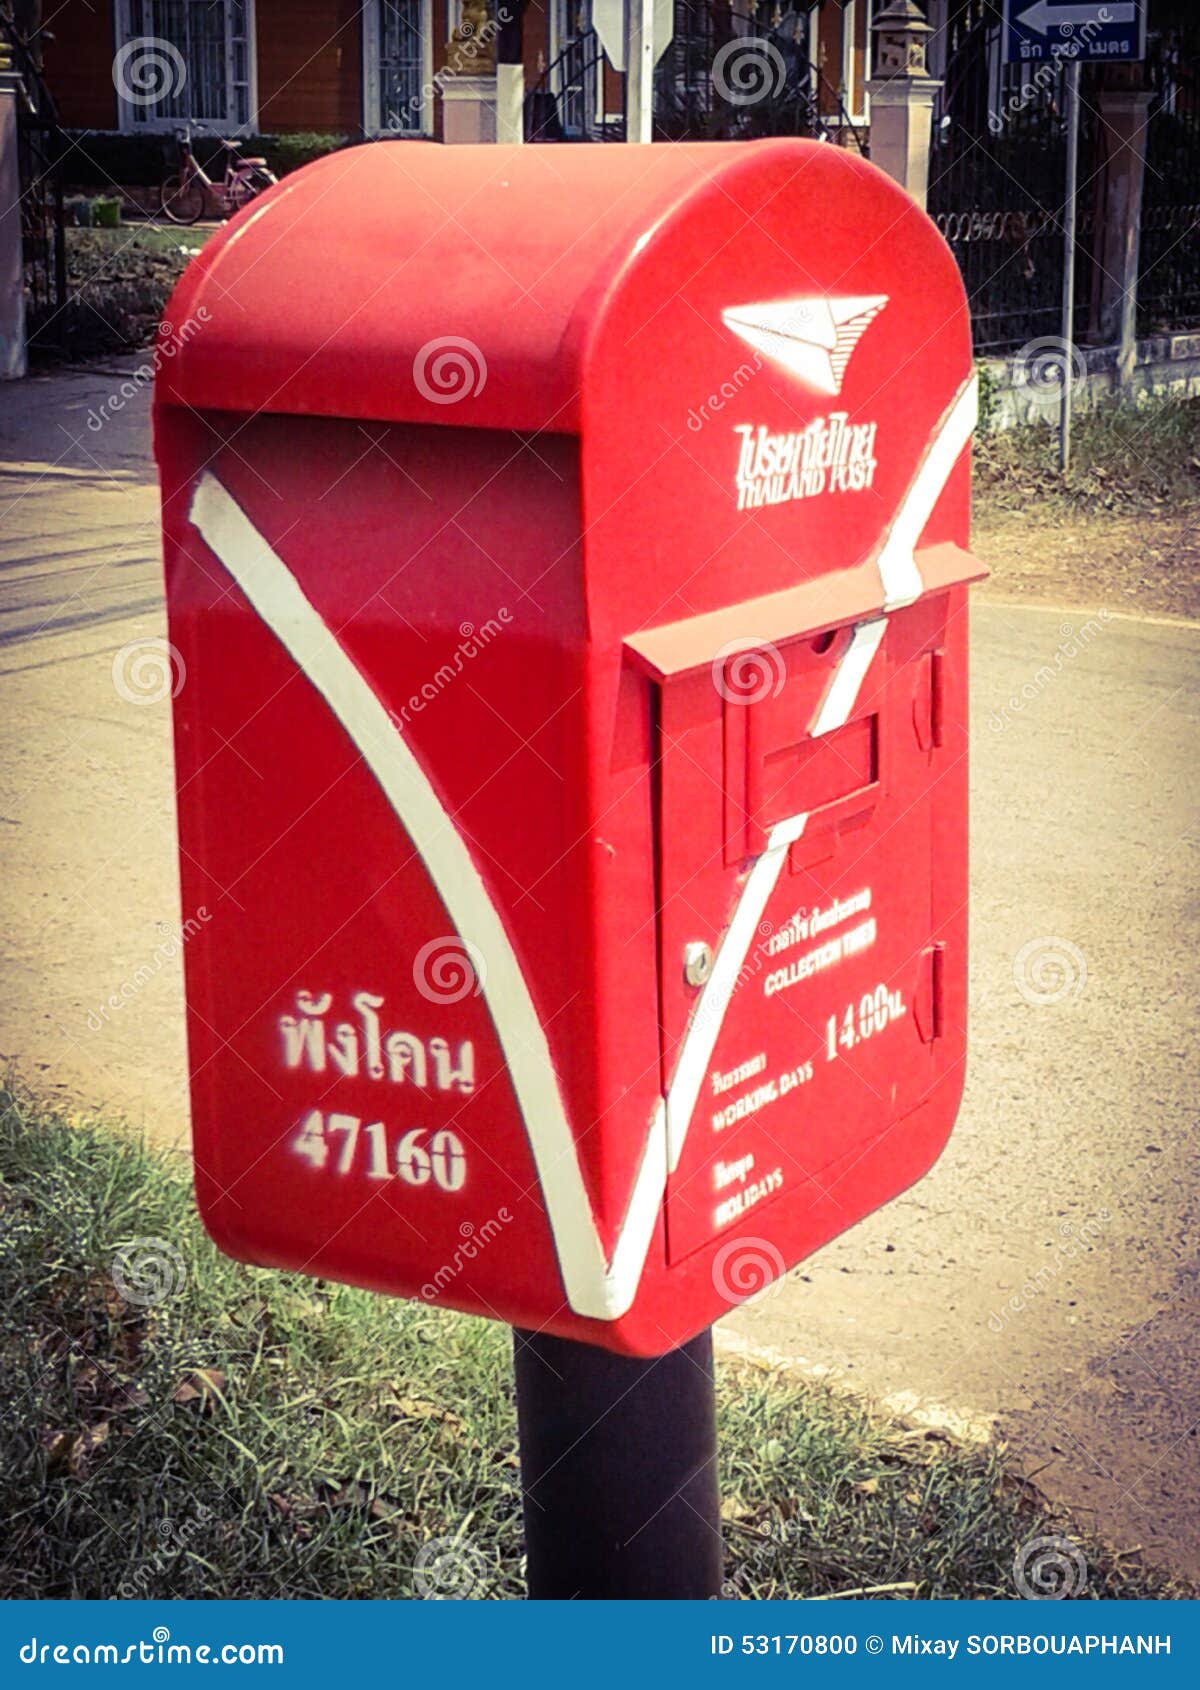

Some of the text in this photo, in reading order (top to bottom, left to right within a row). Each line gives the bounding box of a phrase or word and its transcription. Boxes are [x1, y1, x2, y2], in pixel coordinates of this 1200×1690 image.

[736, 458, 878, 511] THAILAND POST
[764, 937, 842, 997] COLLECTION
[279, 990, 475, 1094] พังโคน
[712, 1060, 814, 1133] WORKING DAYS
[293, 1110, 467, 1192] 47160
[713, 1167, 784, 1229] HOLIDAYS
